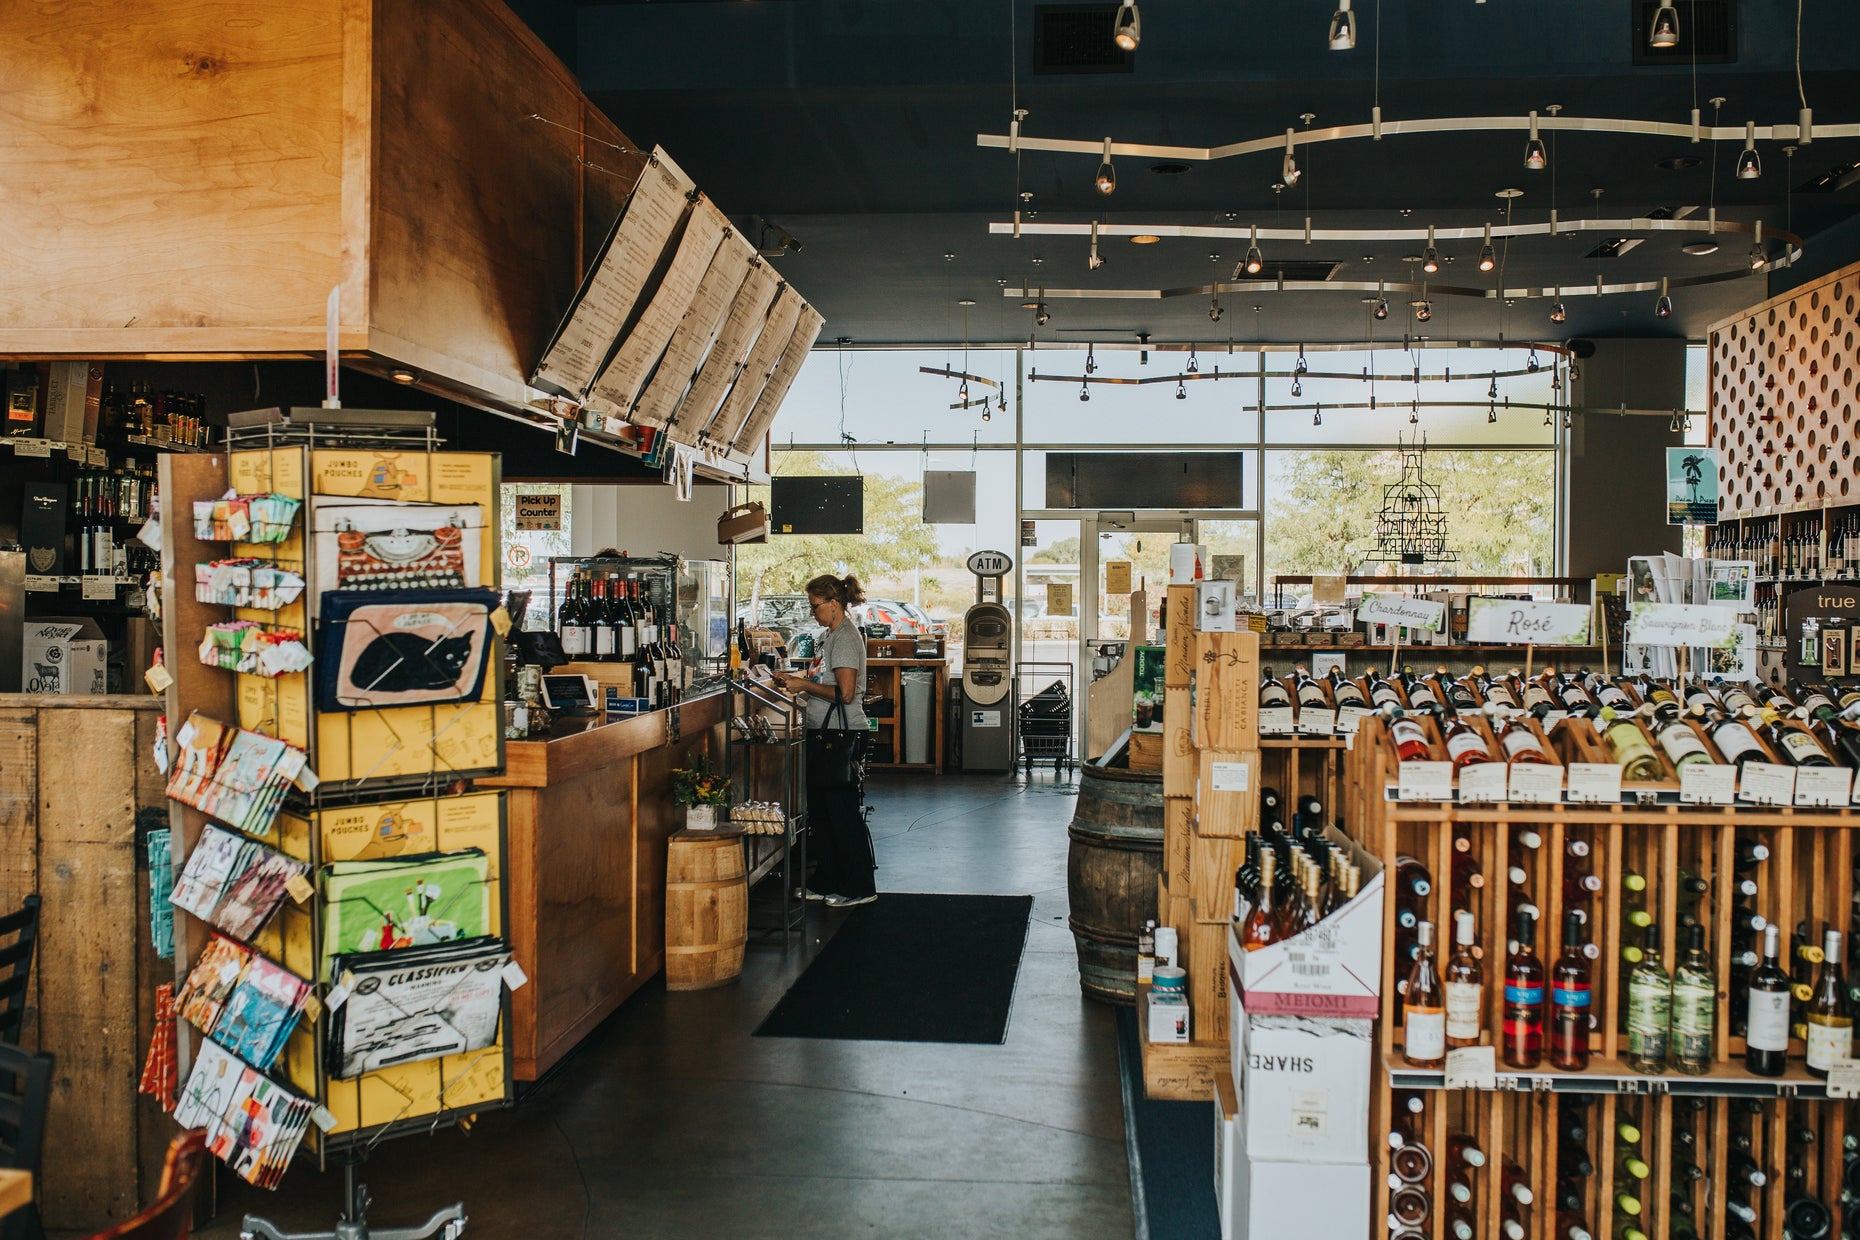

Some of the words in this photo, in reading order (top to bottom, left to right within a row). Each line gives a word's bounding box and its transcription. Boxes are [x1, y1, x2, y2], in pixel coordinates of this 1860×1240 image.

[327, 460, 359, 468] JUMBO
[323, 469, 364, 477] POUCHES
[521, 495, 541, 504] Pick
[543, 496, 556, 506] Up
[520, 508, 557, 517] Counter
[976, 558, 1002, 570] ATM
[1817, 594, 1856, 608] true
[1369, 600, 1430, 624] Chardonnay
[1507, 610, 1552, 636] Rosé
[1640, 614, 1696, 636] Sauvignon
[1699, 617, 1728, 634] Blanc
[334, 815, 364, 826] JUMBO
[330, 824, 370, 835] POUCHES
[1274, 992, 1348, 1008] MEIOMI
[1247, 1054, 1314, 1073] SHARE
